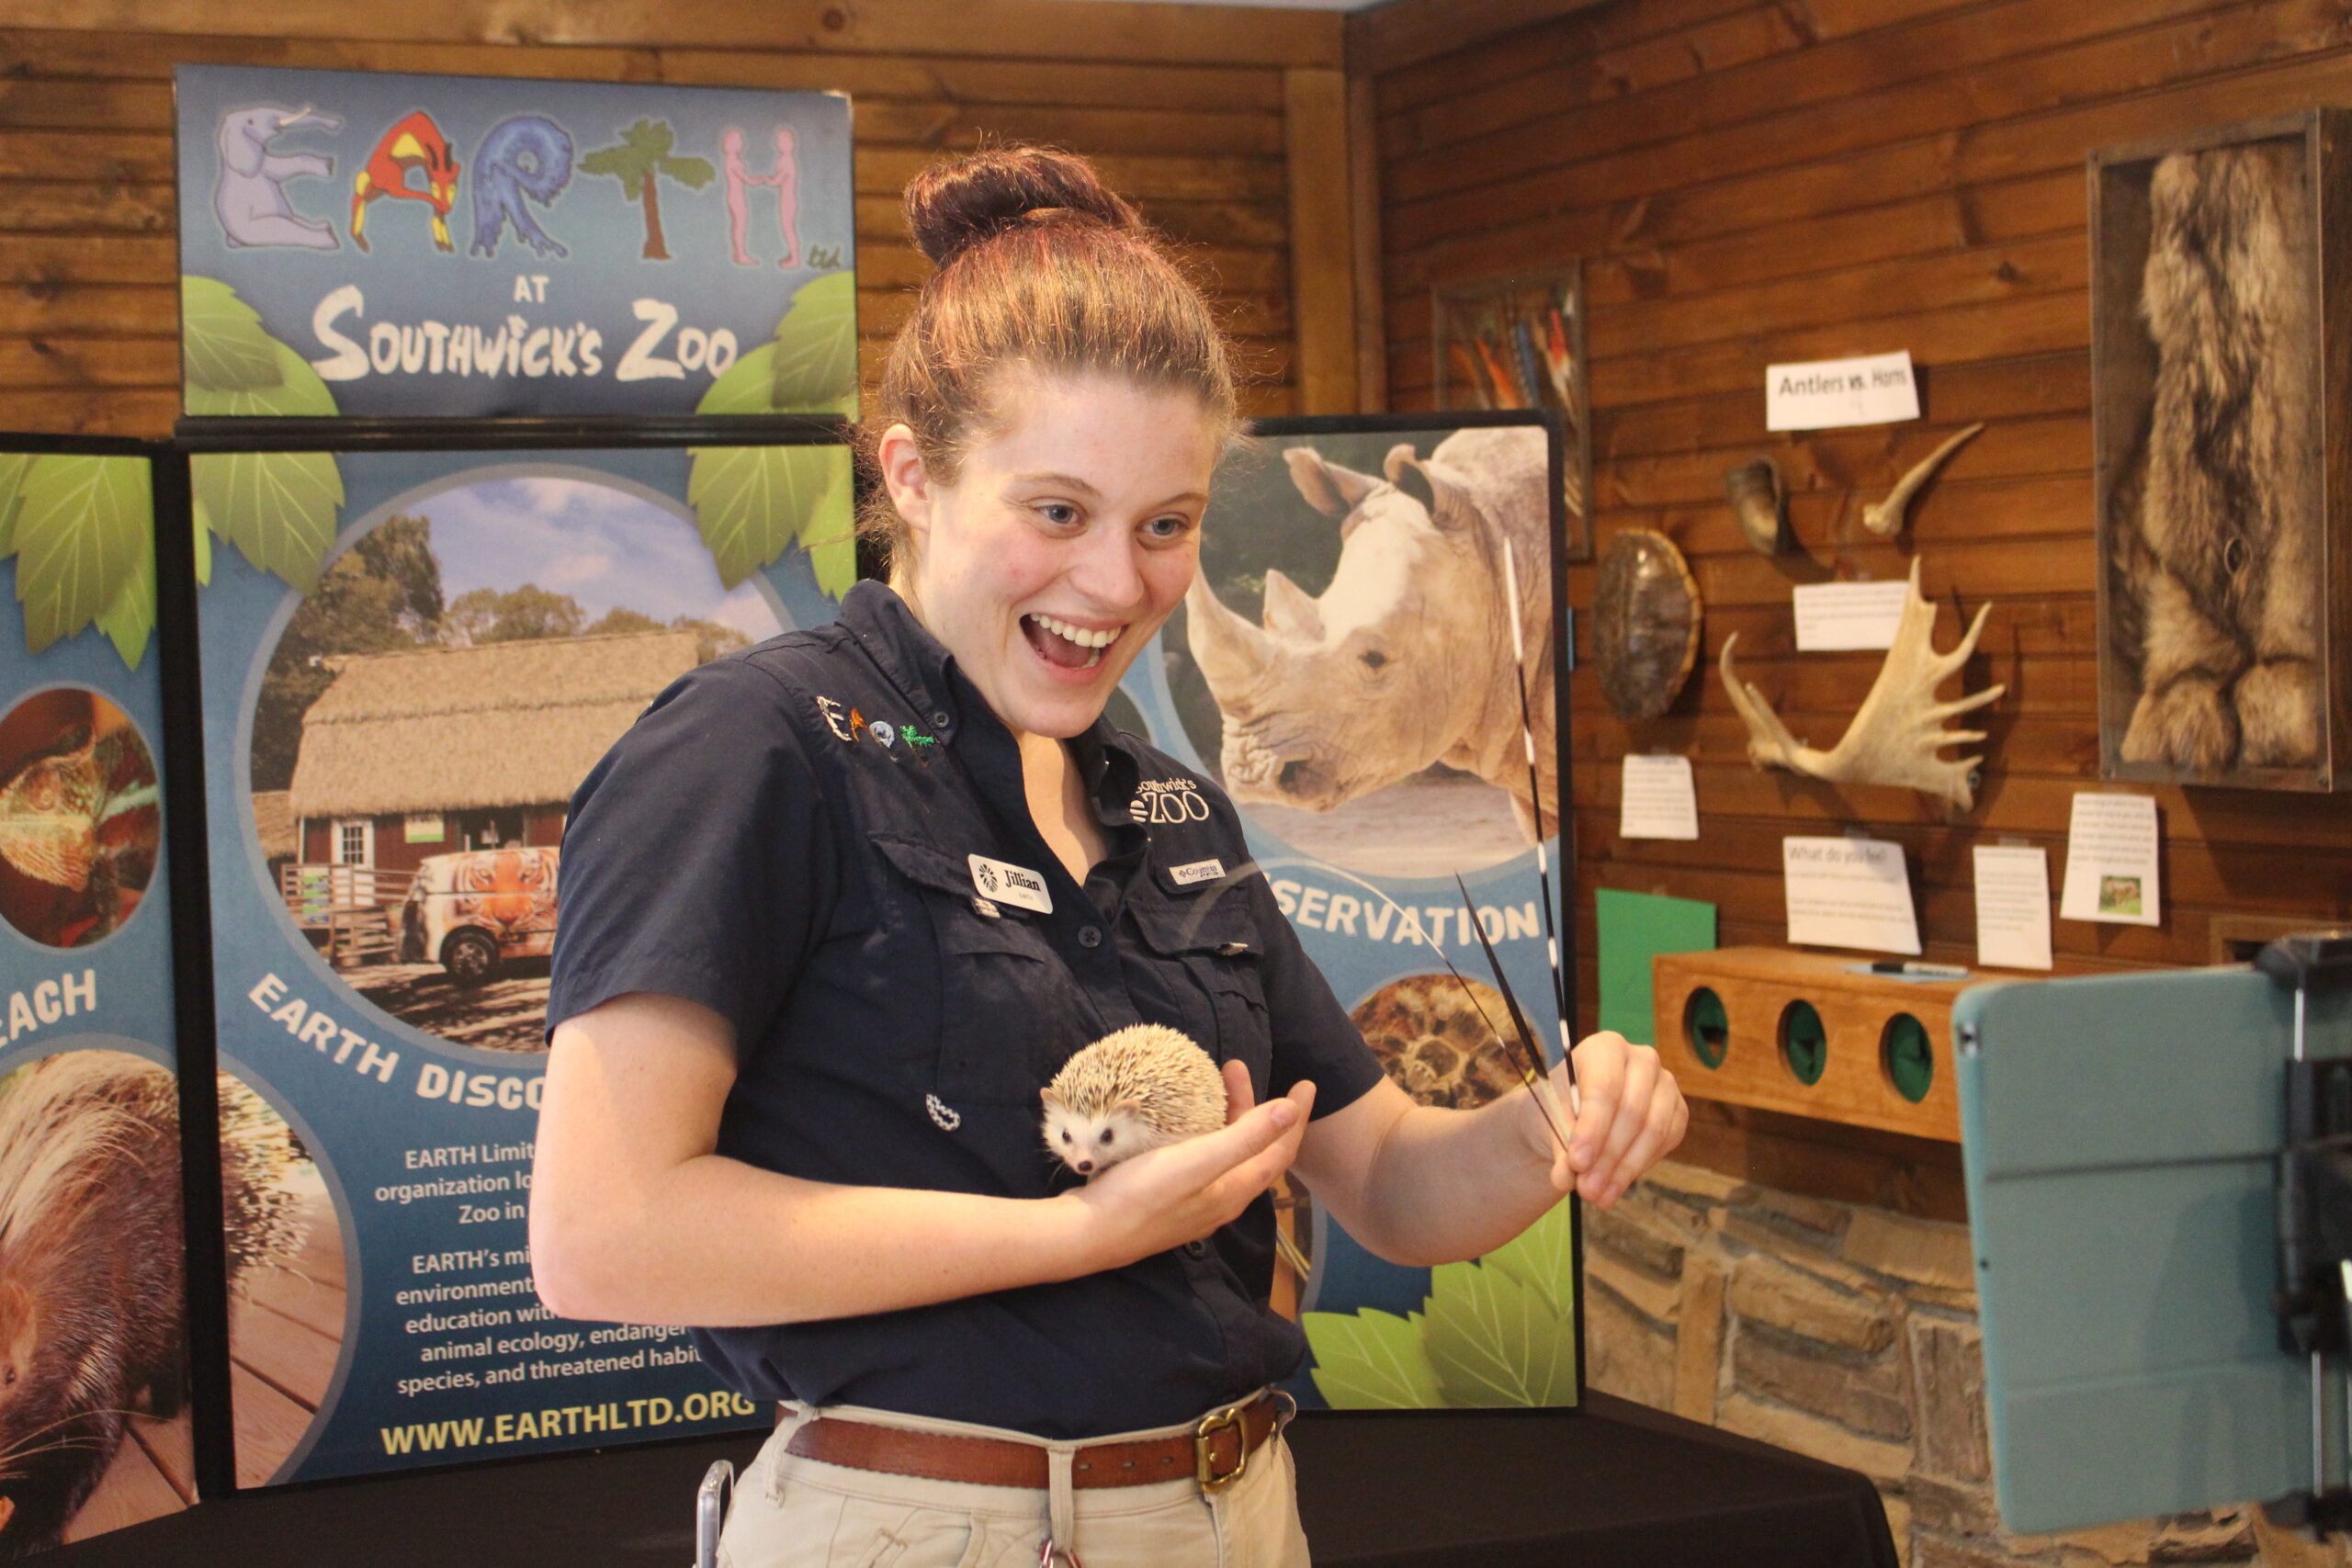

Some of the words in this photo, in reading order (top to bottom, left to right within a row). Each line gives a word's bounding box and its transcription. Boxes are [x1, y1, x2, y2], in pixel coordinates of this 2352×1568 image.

[215, 105, 801, 269] EARTH
[513, 276, 549, 303] AT
[1780, 373, 1844, 396] Antlers
[1141, 791, 1209, 823] ZOO
[1004, 869, 1042, 892] Jillian
[1263, 872, 1540, 947] SERVATION
[247, 972, 400, 1084] EARTH
[405, 1145, 477, 1169] EARTH
[375, 1173, 510, 1204] organization
[458, 1205, 501, 1224] Zoo
[504, 1201, 525, 1220] in
[412, 1248, 500, 1274] EARTH's
[396, 1276, 537, 1305] environment
[405, 1308, 512, 1334] education
[421, 1335, 492, 1362] animal
[497, 1327, 585, 1354] ecology,
[397, 1367, 481, 1397] species,
[485, 1362, 526, 1385] and
[530, 1349, 645, 1380] threatened
[380, 1391, 756, 1455] WWW.EARTHLTD.ORG
